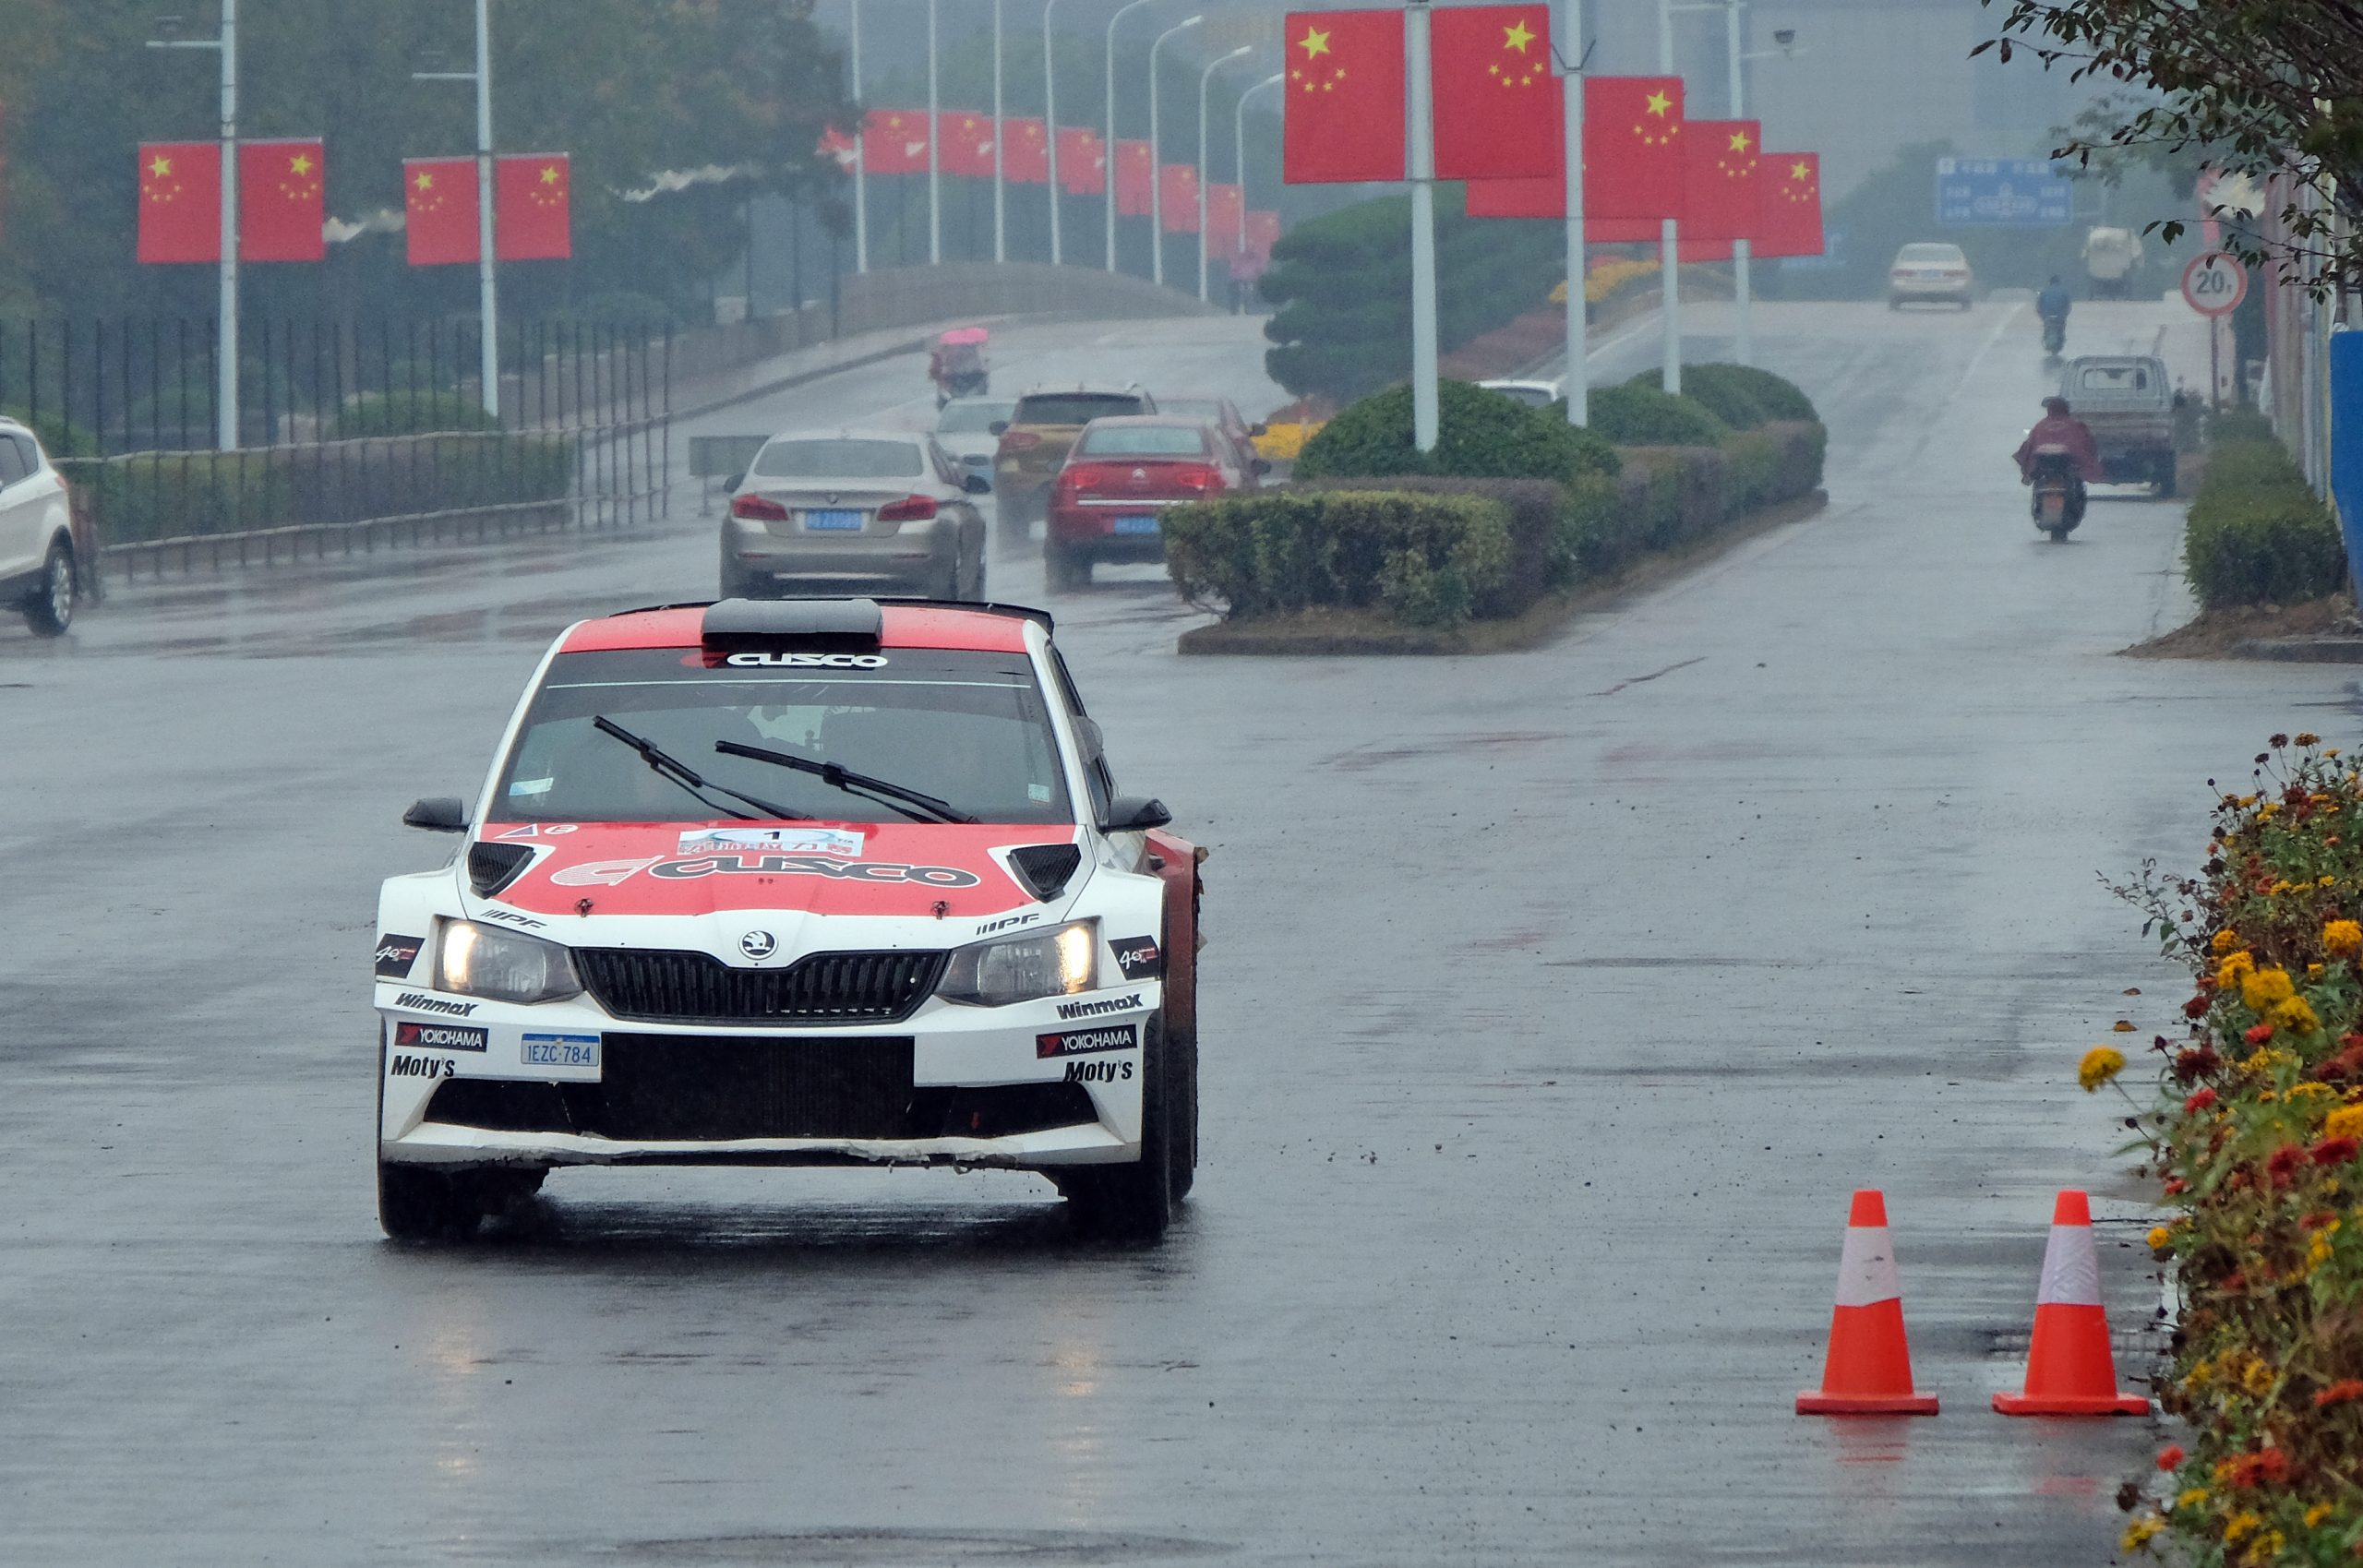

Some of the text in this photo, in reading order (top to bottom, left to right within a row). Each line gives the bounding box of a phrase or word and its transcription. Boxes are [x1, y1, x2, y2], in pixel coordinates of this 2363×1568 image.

[727, 652, 888, 667] CUSCO
[764, 832, 780, 840] 1
[647, 856, 981, 888] CUSCO
[395, 992, 478, 1018] Winmax
[1056, 993, 1143, 1020] Winmax
[419, 1028, 483, 1047] YOKOHAMA
[1062, 1029, 1133, 1050] YOKOHAMA
[390, 1055, 455, 1080] Moty's
[1064, 1061, 1134, 1083] Moty's
